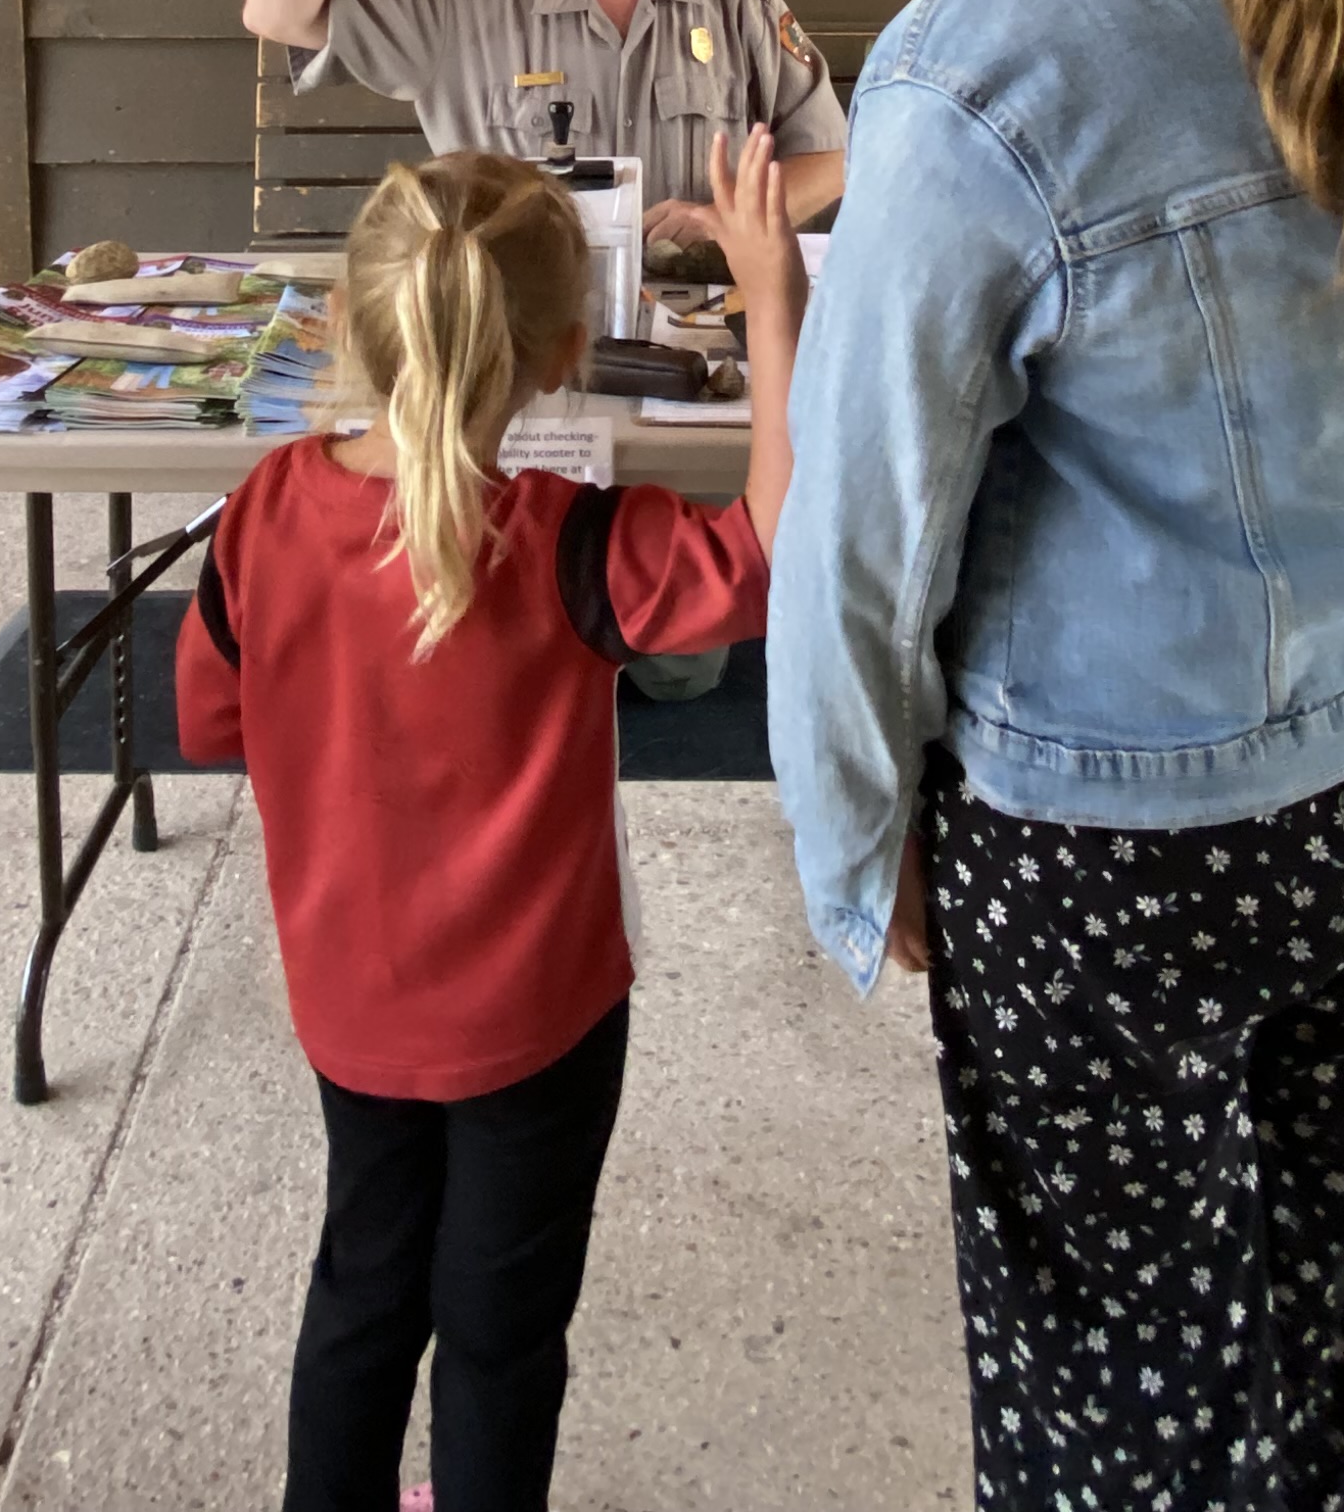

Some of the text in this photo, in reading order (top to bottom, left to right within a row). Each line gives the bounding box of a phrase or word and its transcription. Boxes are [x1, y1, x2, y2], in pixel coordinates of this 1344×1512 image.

[507, 431, 541, 442] about
[533, 450, 576, 458] scooter
[580, 449, 591, 458] to
